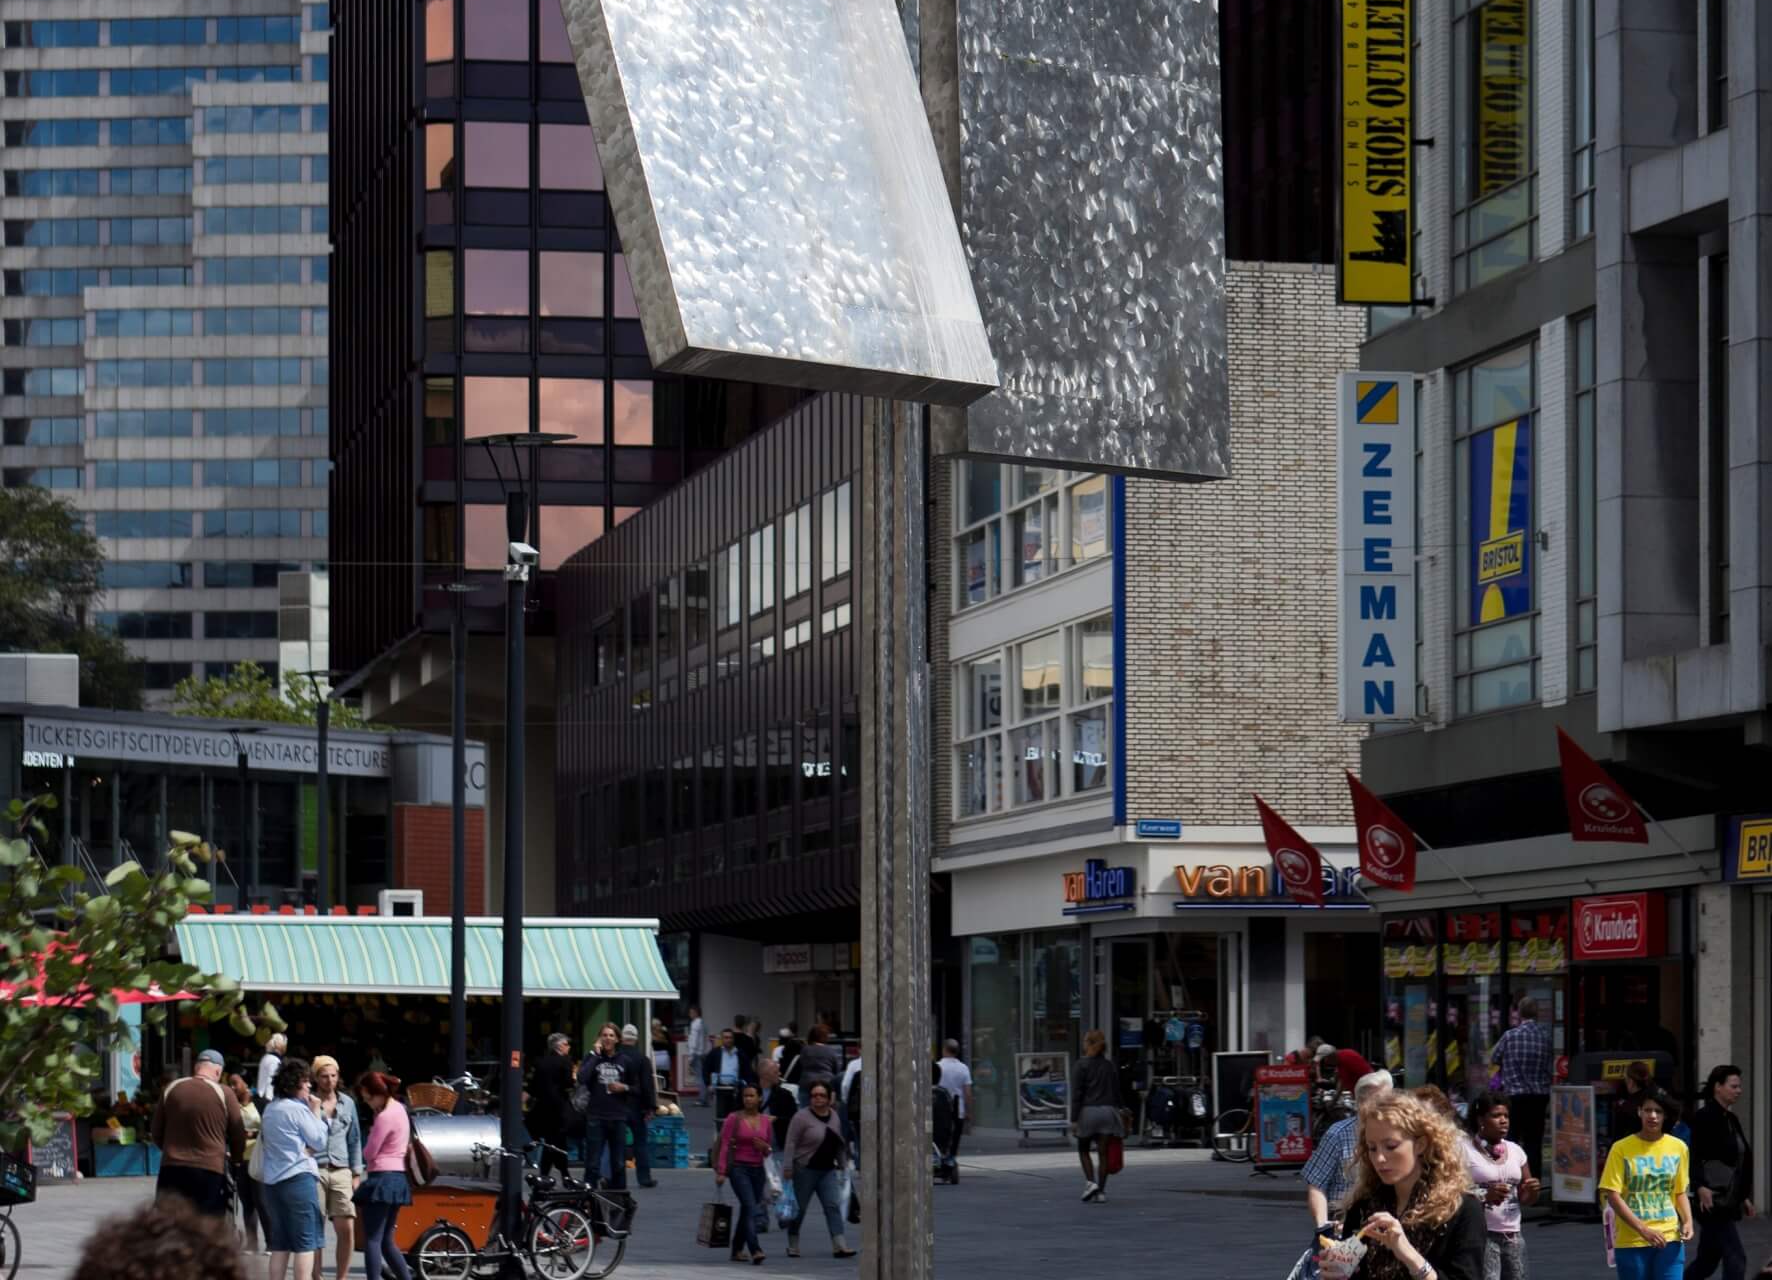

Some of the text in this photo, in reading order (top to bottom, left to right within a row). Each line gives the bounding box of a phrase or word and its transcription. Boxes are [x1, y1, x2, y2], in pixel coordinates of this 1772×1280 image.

[1347, 0, 1360, 187] SINDS 1864
[1365, 116, 1407, 198] SHOE
[1360, 442, 1397, 716] ZEEMAN
[1482, 544, 1520, 573] BRISTOL
[1584, 822, 1636, 836] Kruidvat
[1594, 912, 1638, 942] Kruidvat
